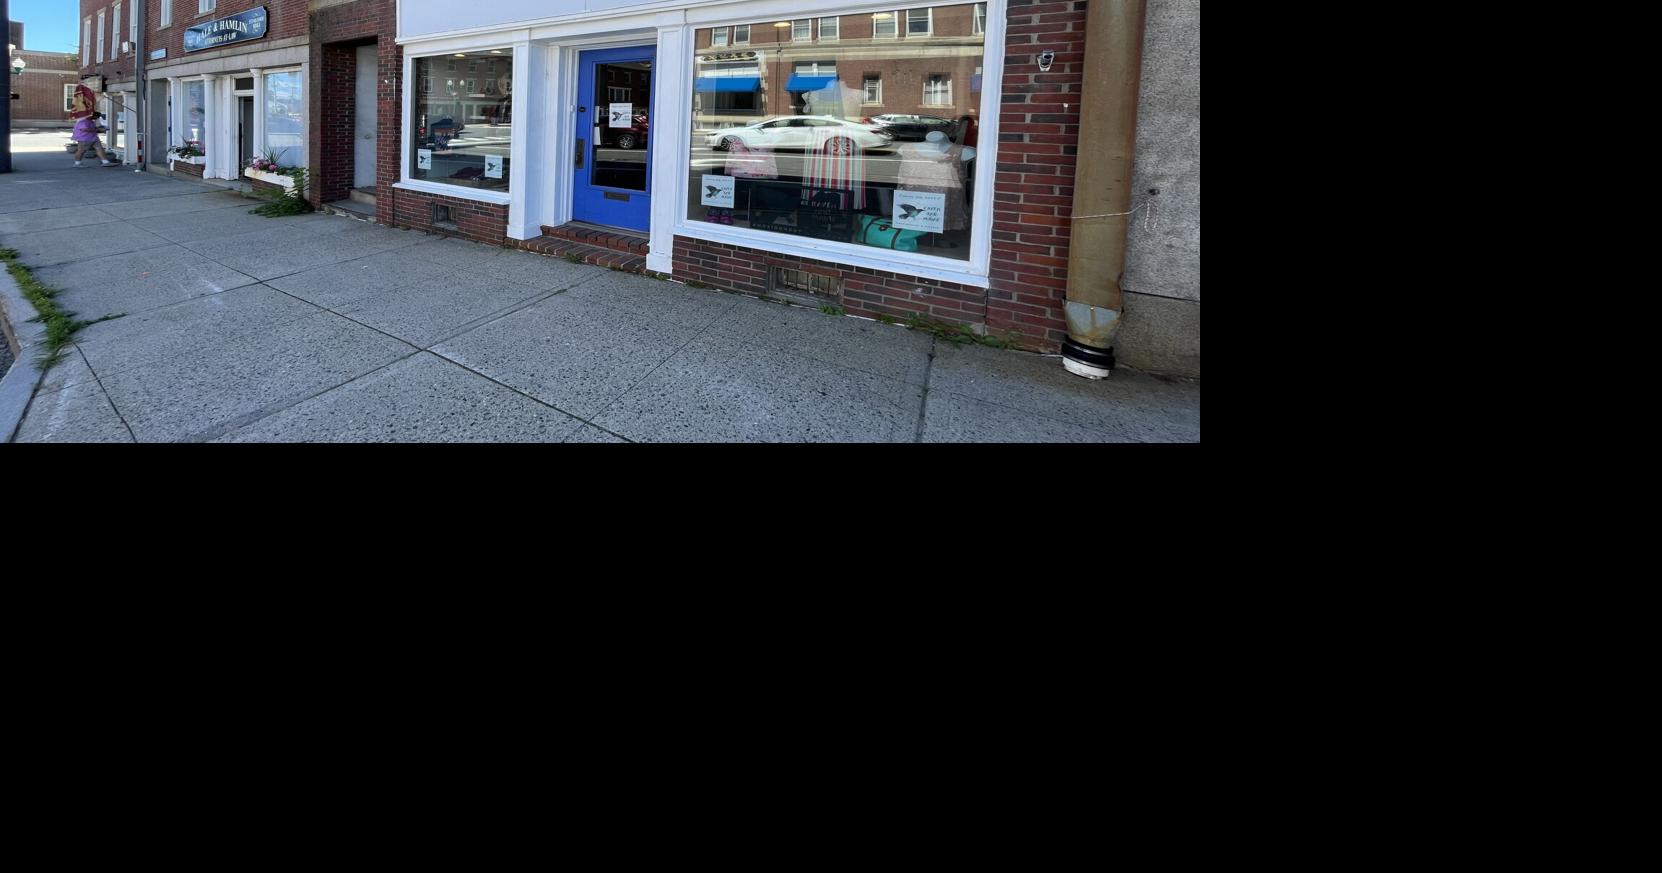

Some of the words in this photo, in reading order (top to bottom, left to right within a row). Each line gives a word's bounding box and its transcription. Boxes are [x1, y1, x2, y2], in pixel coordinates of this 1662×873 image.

[196, 26, 212, 44] HALE
[213, 22, 218, 32] &
[220, 20, 247, 33] HAMLIN
